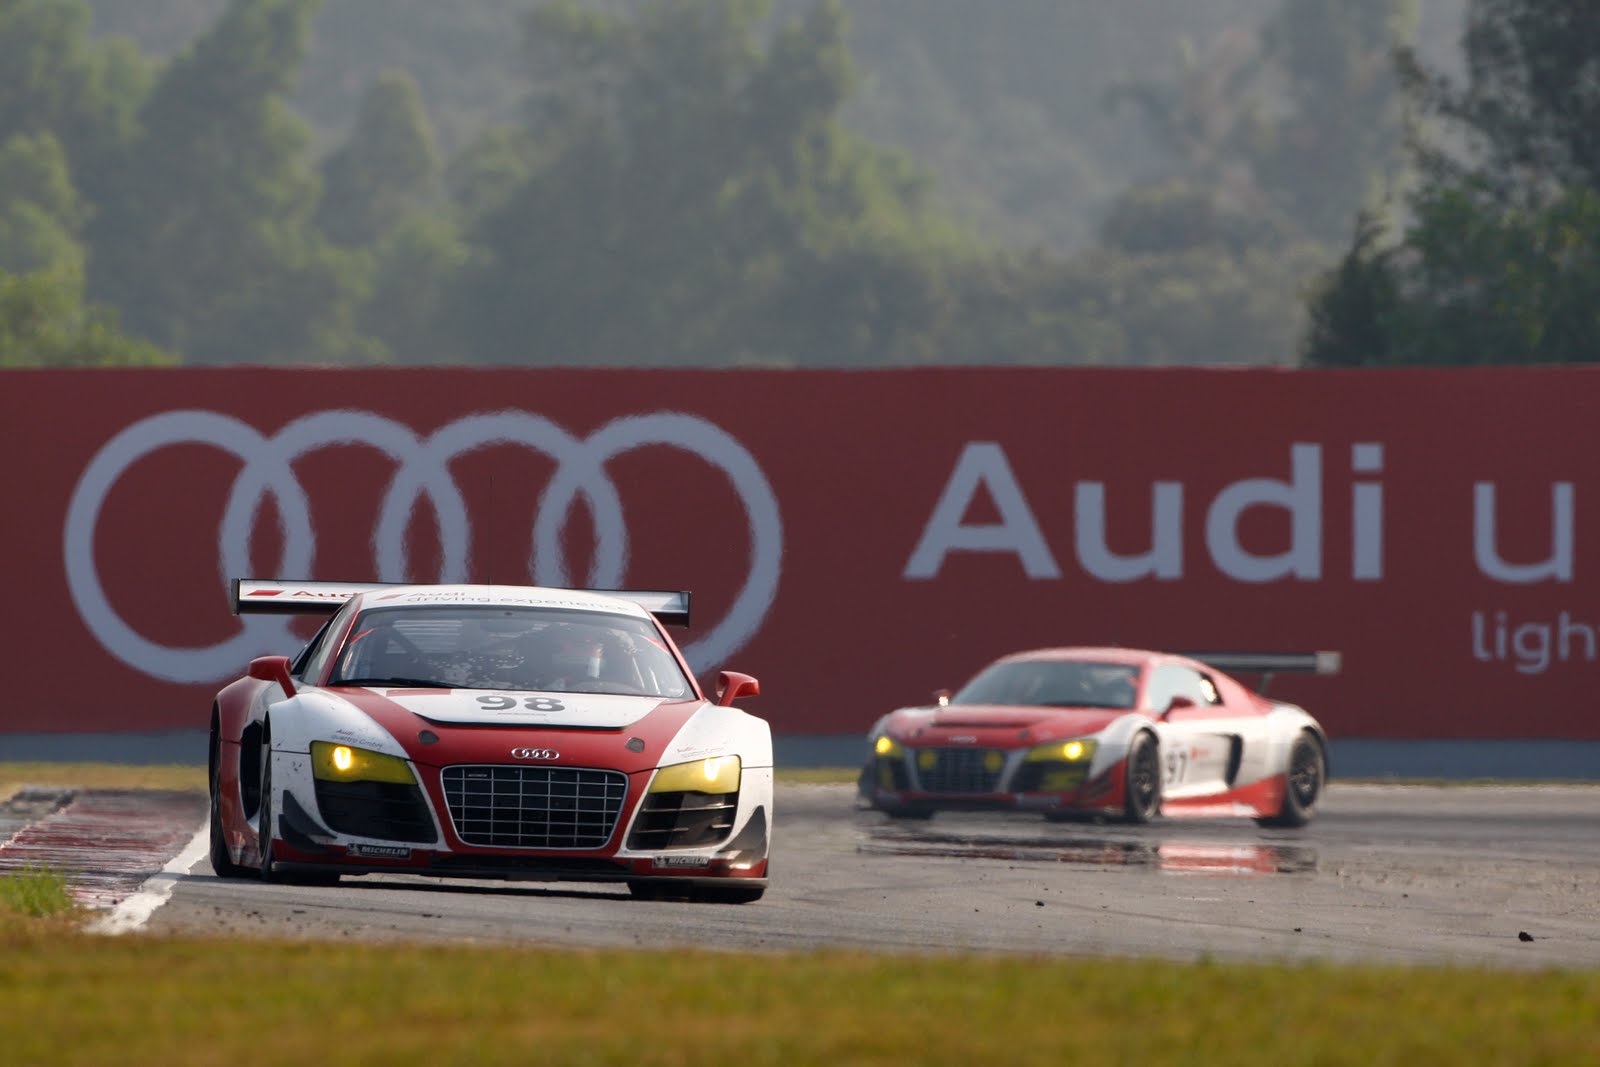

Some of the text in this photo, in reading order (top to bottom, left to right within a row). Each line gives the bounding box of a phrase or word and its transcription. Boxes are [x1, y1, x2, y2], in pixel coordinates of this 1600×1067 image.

[903, 441, 1384, 583] Audi
[292, 590, 359, 600] Aud
[1472, 611, 1600, 674] ligh
[475, 695, 566, 712] 98
[361, 846, 409, 856] MICHELIN
